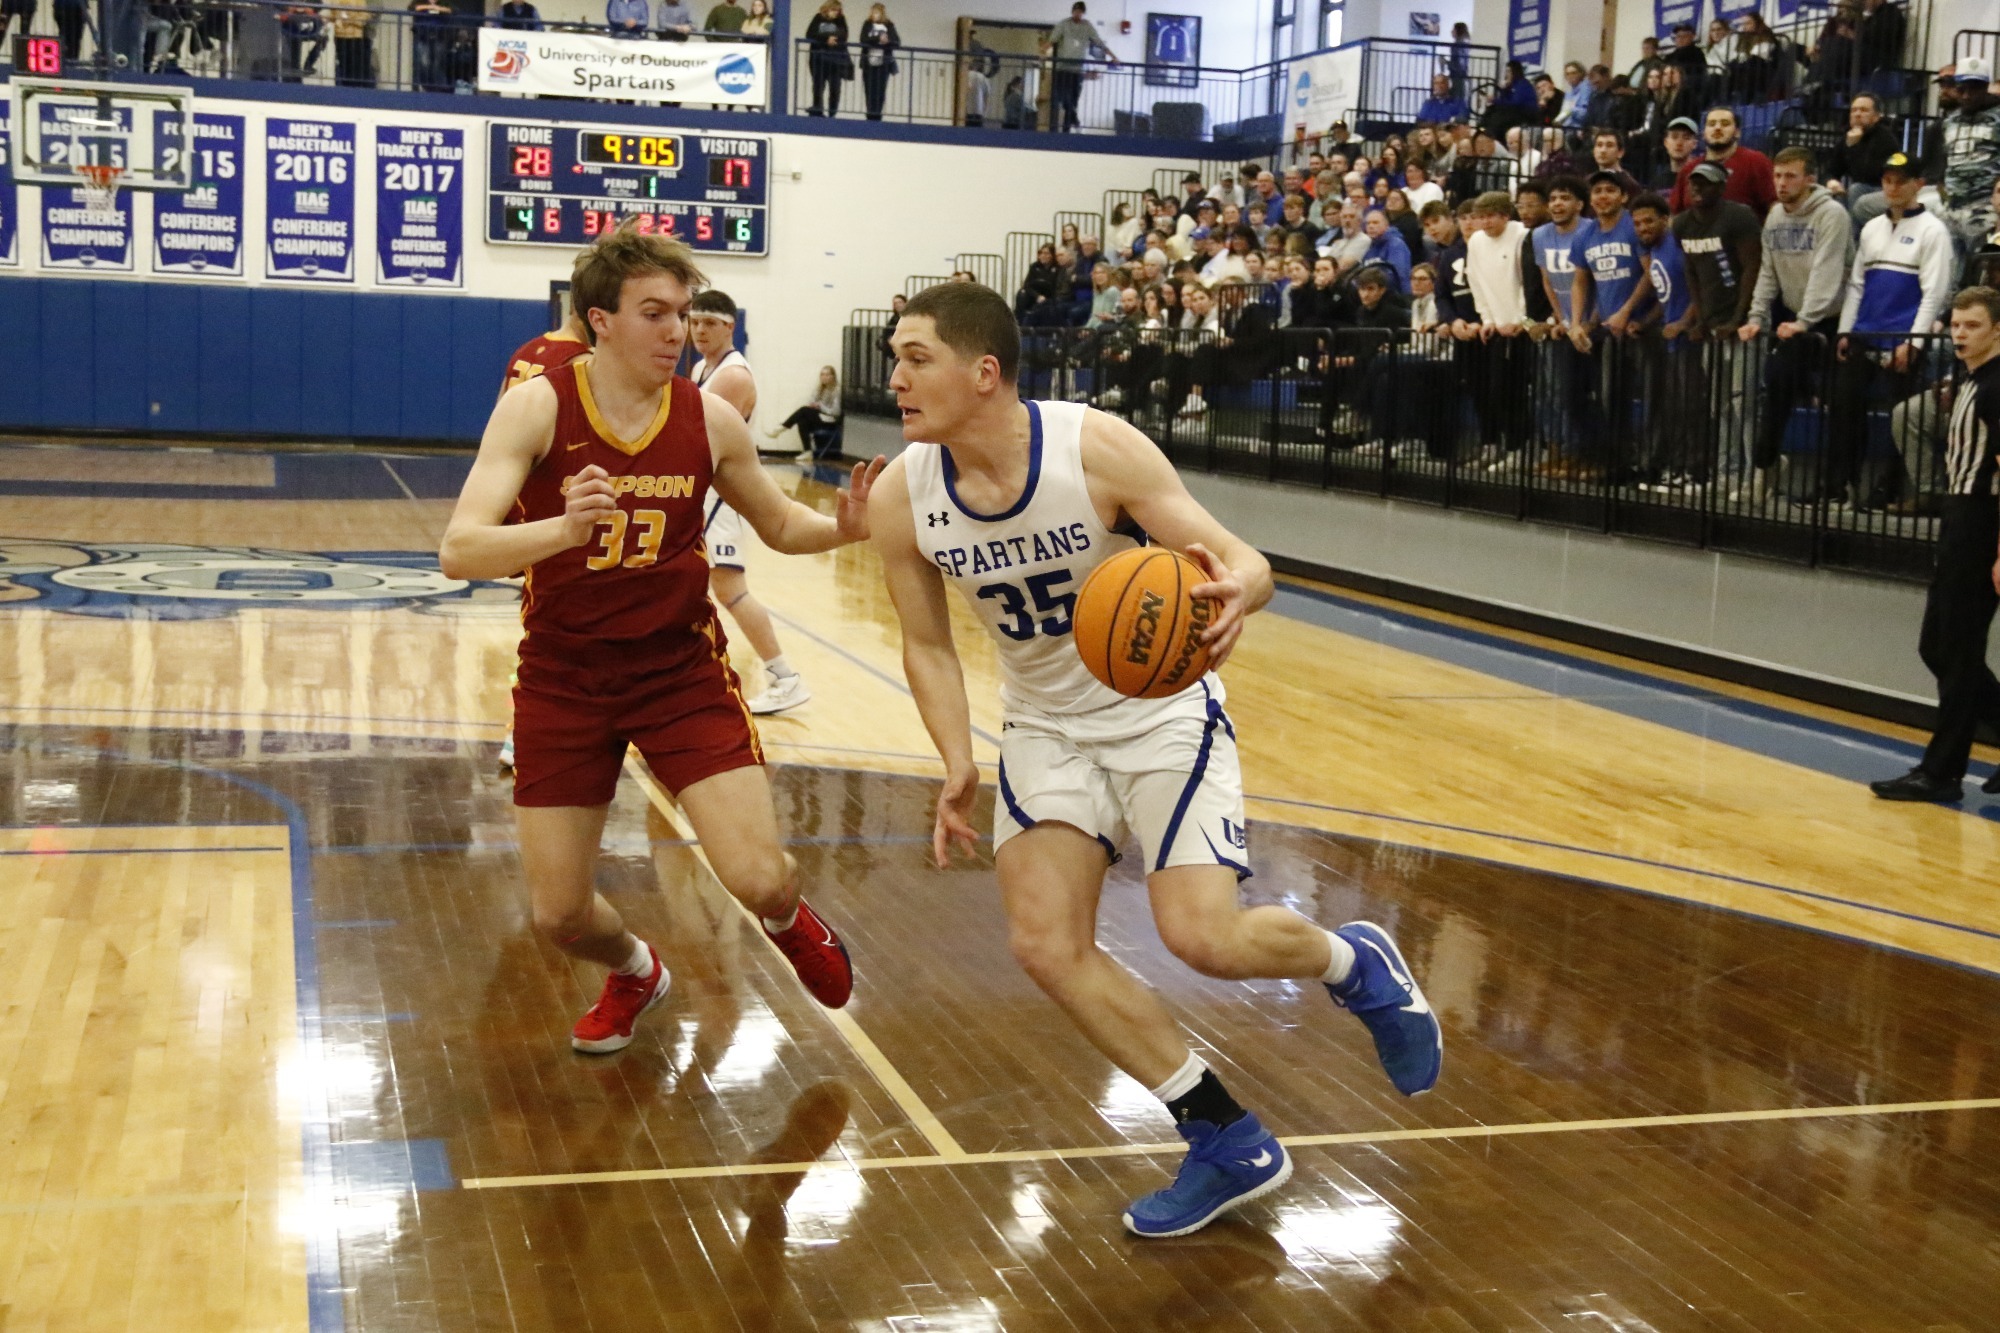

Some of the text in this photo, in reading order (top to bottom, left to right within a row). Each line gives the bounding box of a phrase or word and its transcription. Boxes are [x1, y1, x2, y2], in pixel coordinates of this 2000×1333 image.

[498, 40, 527, 50] NCAA
[28, 39, 59, 72] 18
[539, 48, 709, 69] University of Dubuque
[573, 68, 676, 92] Spartans
[718, 72, 756, 85] NCAA
[54, 107, 123, 124] WOMES
[163, 121, 235, 139] FOTBALL
[289, 123, 333, 138] MEN'S
[401, 130, 443, 145] MEN'S
[507, 126, 553, 144] HOME
[268, 136, 354, 154] BASKETBALL
[378, 143, 462, 160] TRACK & FIELD
[603, 134, 674, 166] 9:05
[700, 138, 758, 156] VISITOR
[275, 153, 347, 184] 2016
[515, 146, 552, 177] 28
[385, 162, 454, 192] 2017
[725, 158, 751, 187] 17
[520, 180, 553, 191] BONUS
[604, 178, 638, 190] PERIOD
[650, 176, 657, 198] 1
[504, 196, 534, 207] FOULS
[705, 189, 737, 201] BONUS
[581, 200, 689, 215] PLAYER POINTS FOULS
[724, 208, 753, 219] FOULS
[48, 208, 126, 227] CONFERENCE
[160, 213, 236, 232] CONFERENCE
[518, 209, 533, 231] 4
[544, 209, 561, 233] 6
[273, 218, 348, 237] CONFERENCE
[401, 224, 437, 238] INDOOR
[696, 216, 713, 240] 5
[736, 218, 751, 241] 6
[51, 228, 125, 247] CHAMPIONS
[162, 233, 234, 252] CHAMPIONS
[391, 239, 447, 253] CONFERENCE
[1681, 237, 1723, 253] SPARTAN
[274, 238, 346, 257] CHAMPIONS
[1585, 241, 1632, 263] SPARTAN
[392, 254, 446, 268] CHAMPIONS
[560, 476, 695, 498] SPSON
[587, 509, 666, 570] 33
[934, 522, 1091, 577] SPARTANS
[977, 568, 1079, 641] 35
[1126, 588, 1165, 665] NCAA
